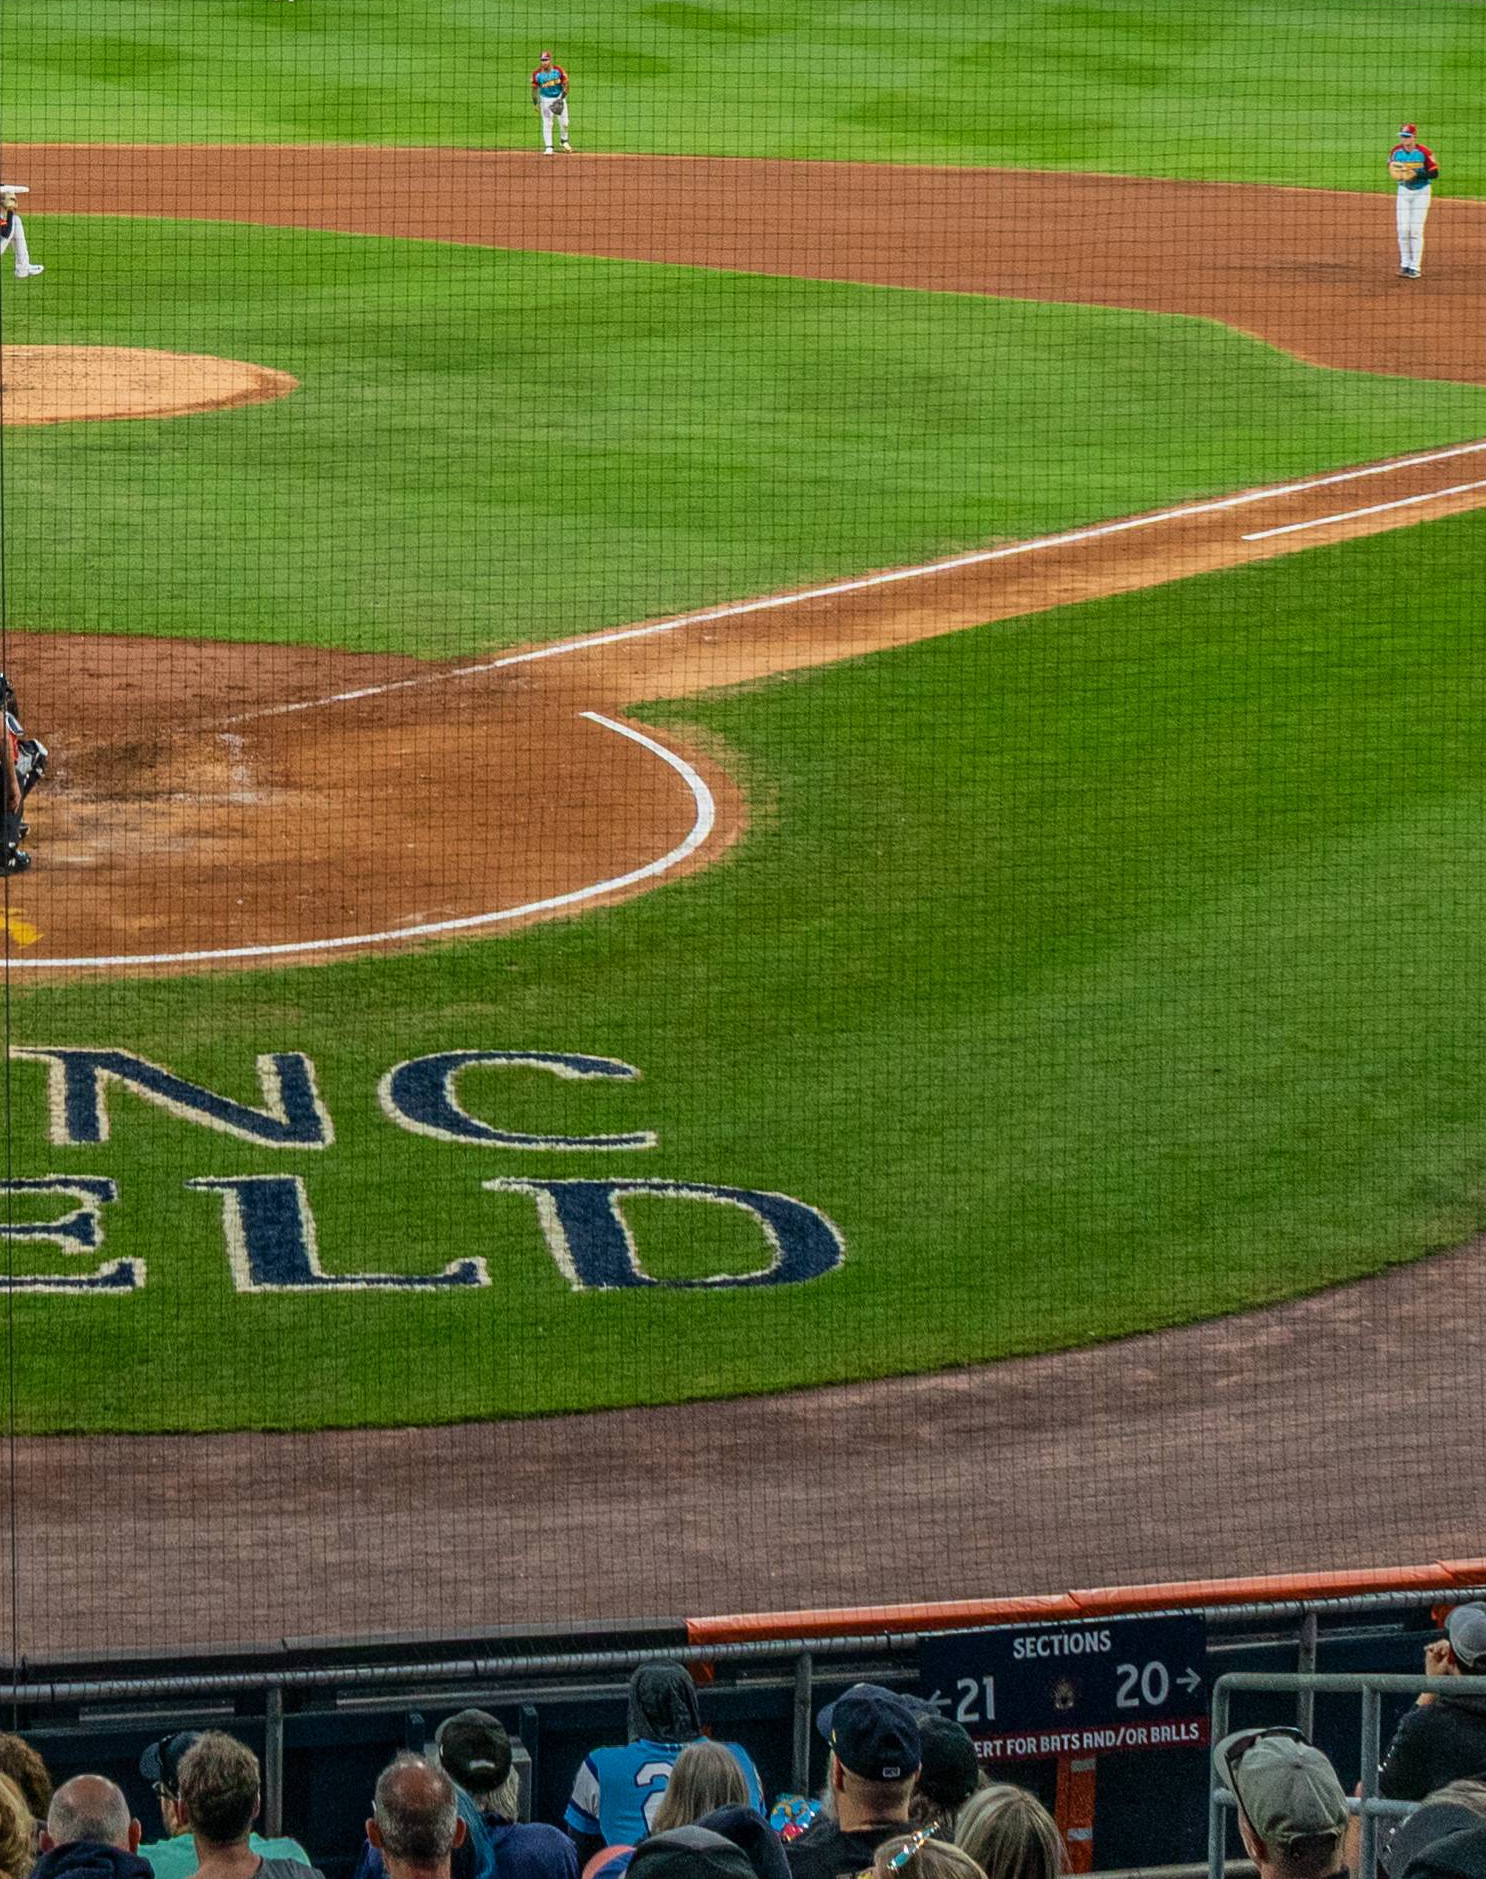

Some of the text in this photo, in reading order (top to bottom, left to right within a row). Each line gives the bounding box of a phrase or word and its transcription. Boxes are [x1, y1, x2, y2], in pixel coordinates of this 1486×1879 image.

[1012, 1629, 1112, 1660] SECTIONS
[956, 1660, 1170, 1723] 21 20
[1006, 1722, 1200, 1757] FOR BATS AND/OR BALLS
